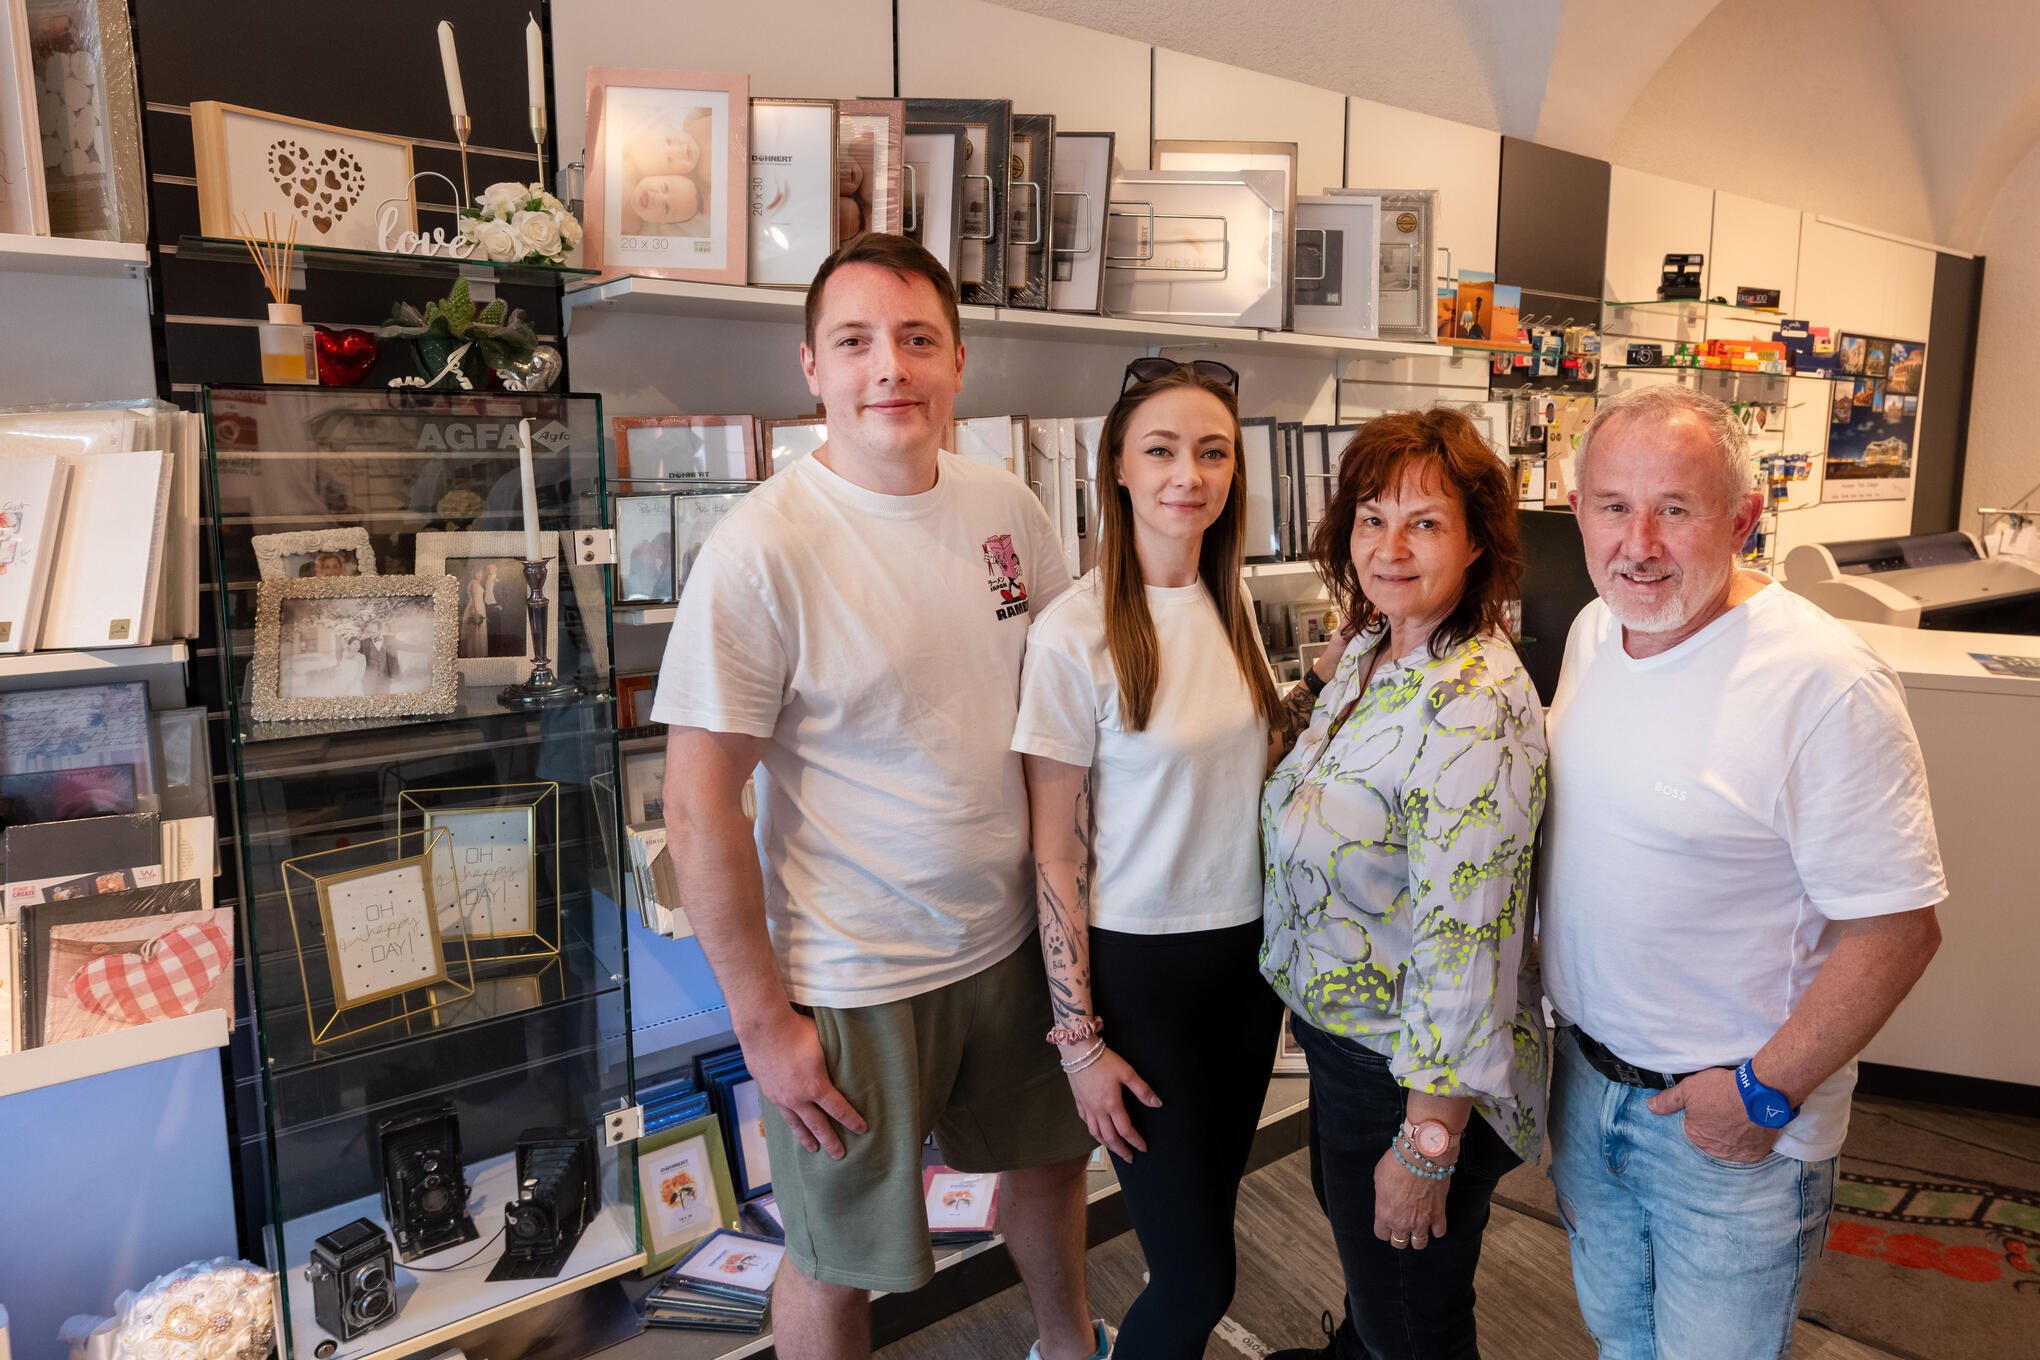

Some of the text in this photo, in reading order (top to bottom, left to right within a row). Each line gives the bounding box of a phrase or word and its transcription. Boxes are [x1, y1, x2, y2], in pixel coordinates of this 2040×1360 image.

[752, 177, 764, 191] 30
[752, 202, 764, 217] 20
[378, 206, 476, 259] love
[620, 237, 637, 249] 20
[652, 238, 669, 250] 30
[416, 423, 526, 449] AGFA
[995, 600, 1029, 621] RAME
[1655, 781, 1687, 801] BOSS
[465, 847, 493, 865] OH
[465, 880, 506, 912] DAY!
[365, 901, 395, 921] OH
[370, 931, 415, 963] DAY!
[1824, 1220, 2004, 1283] ESS
